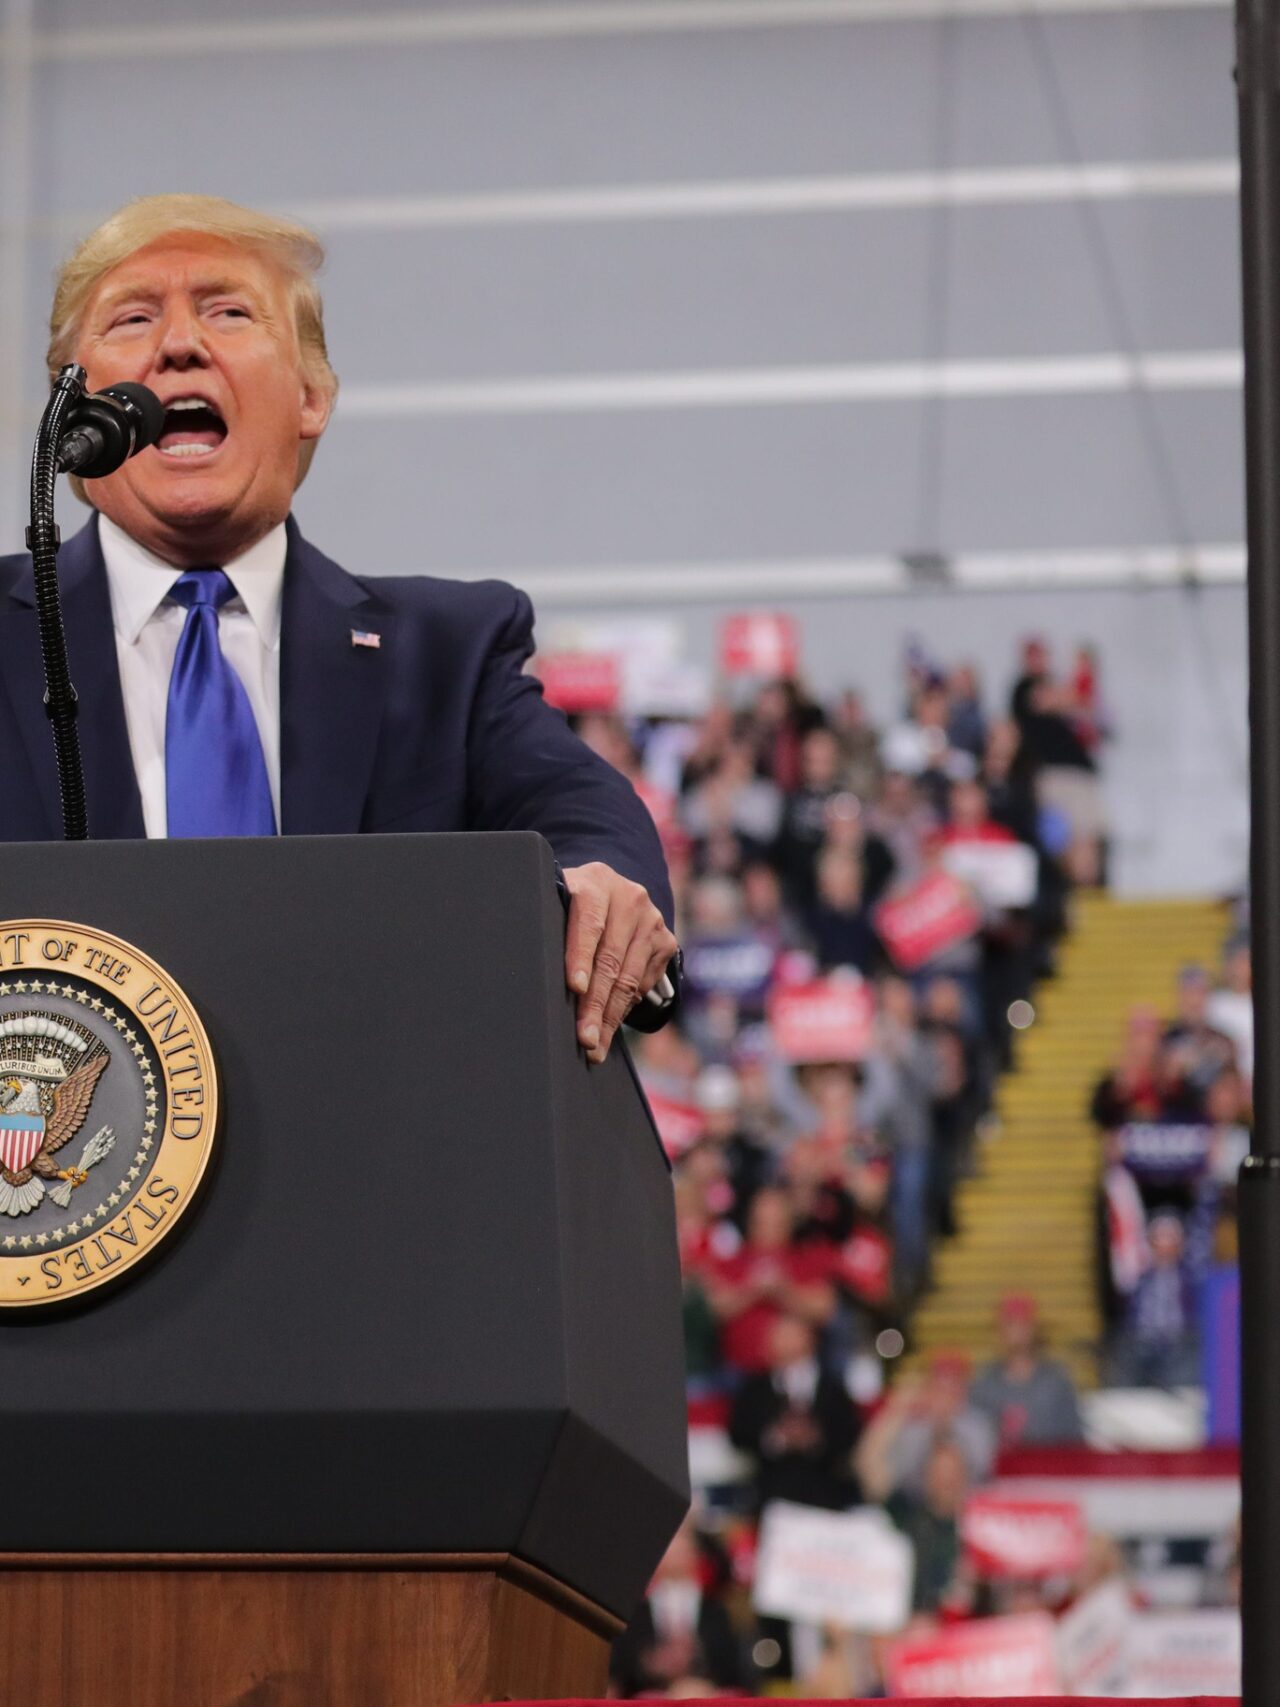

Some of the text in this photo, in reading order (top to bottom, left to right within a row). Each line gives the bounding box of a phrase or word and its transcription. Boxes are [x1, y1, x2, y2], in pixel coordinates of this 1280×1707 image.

[40, 936, 79, 962] OF
[85, 946, 133, 987] THE
[37, 1066, 64, 1075] UNUM
[135, 980, 205, 1141] UNITED
[39, 1174, 180, 1291] STATES
